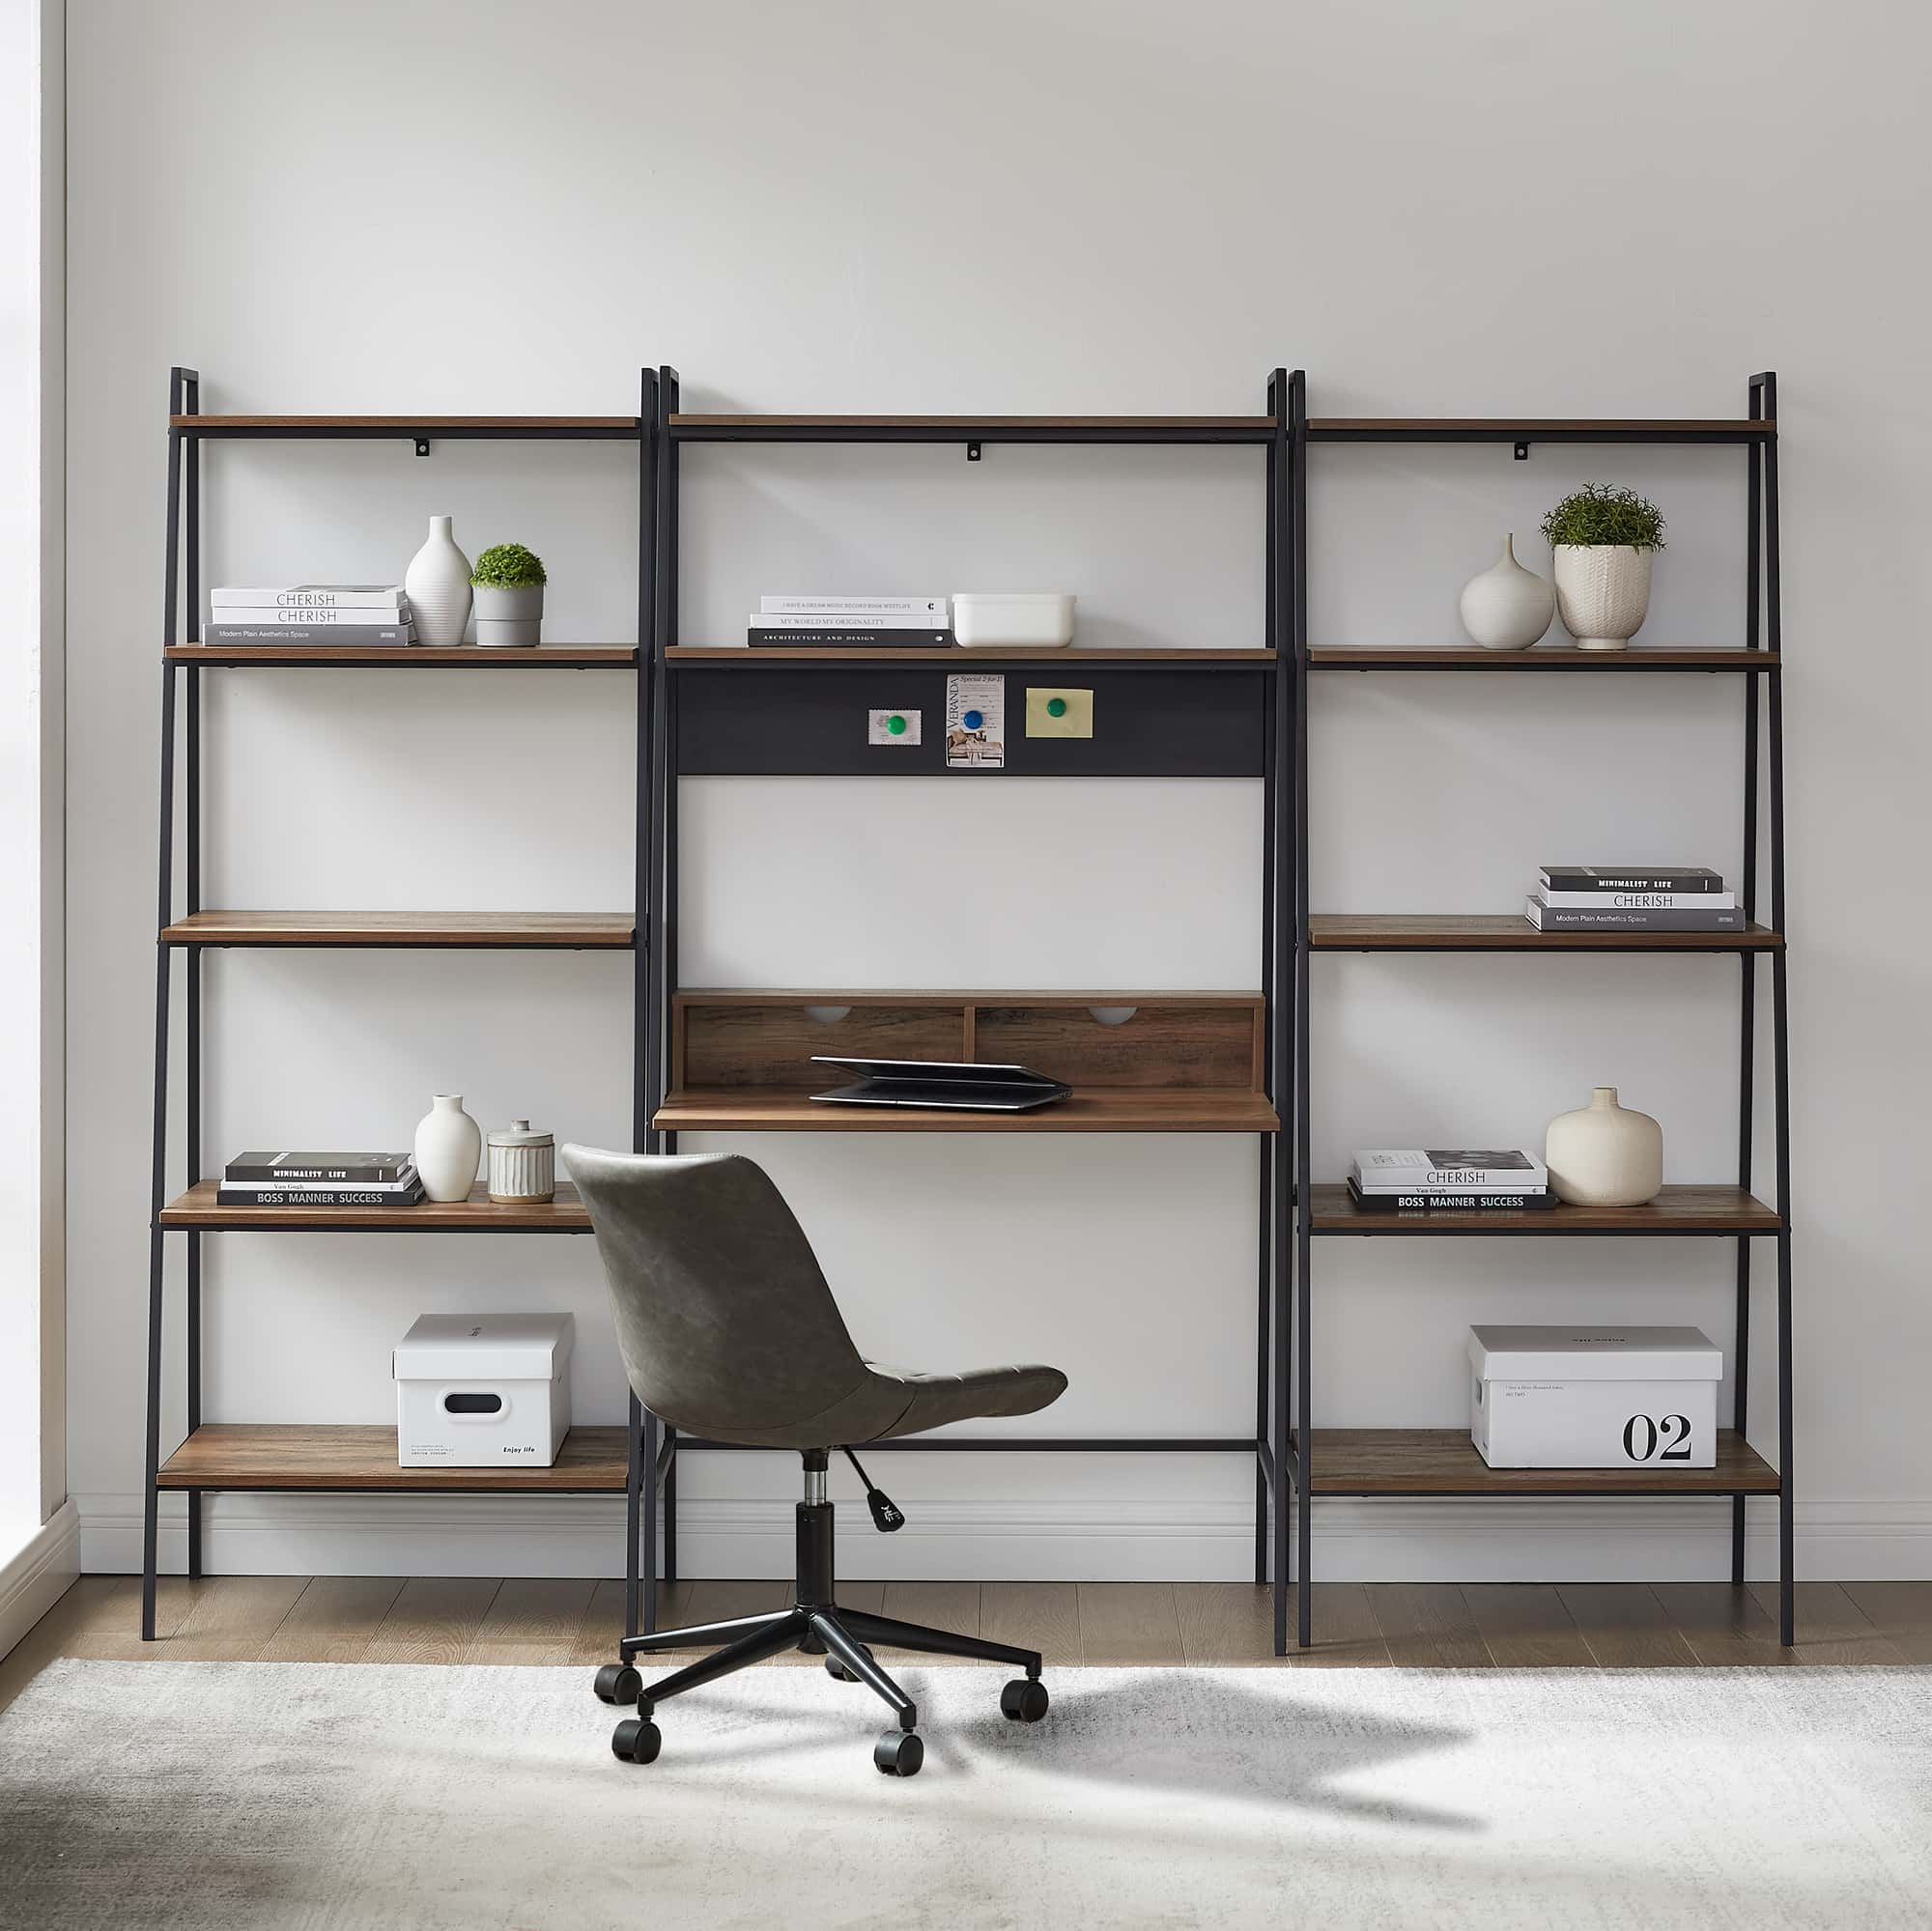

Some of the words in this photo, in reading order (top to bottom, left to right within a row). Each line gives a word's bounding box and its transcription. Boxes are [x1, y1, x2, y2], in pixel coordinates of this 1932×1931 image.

[276, 593, 335, 606] CHERISH
[277, 610, 337, 622] CHERISH
[291, 631, 309, 639] Space
[947, 677, 959, 728] VERANDA
[1654, 880, 1672, 889] LIFE
[1613, 895, 1673, 907] CHERISH
[328, 1170, 347, 1178] LIFE
[1427, 1172, 1486, 1183] CHERISH
[257, 1193, 283, 1203] BOSS
[289, 1193, 334, 1204] MANNER
[339, 1193, 383, 1203] SUCCESS
[1398, 1197, 1425, 1207] BOSS
[1430, 1197, 1476, 1207] MANNER
[1480, 1197, 1524, 1207] SUCCESS
[1623, 1414, 1691, 1462] 02
